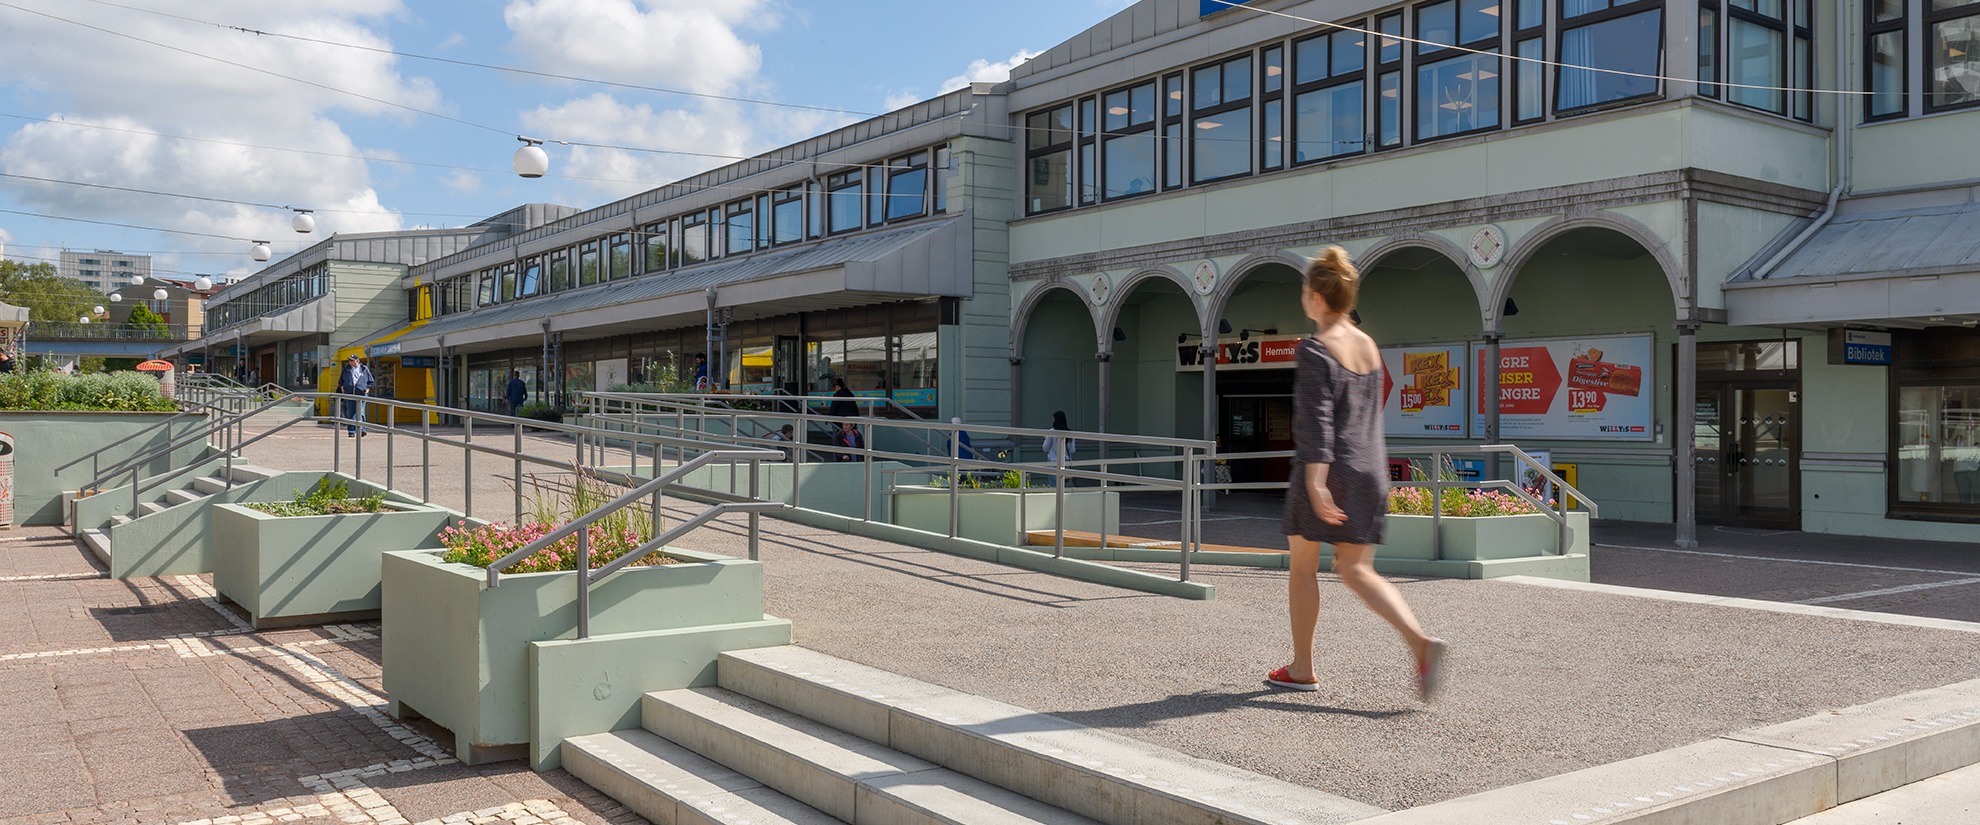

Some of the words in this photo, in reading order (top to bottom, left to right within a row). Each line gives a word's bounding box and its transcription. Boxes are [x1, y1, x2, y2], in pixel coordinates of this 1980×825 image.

[1265, 347, 1295, 356] Hemma
[1847, 346, 1885, 361] Bibliotek
[1572, 375, 1609, 387] Digestive
[1572, 391, 1597, 408] 1390
